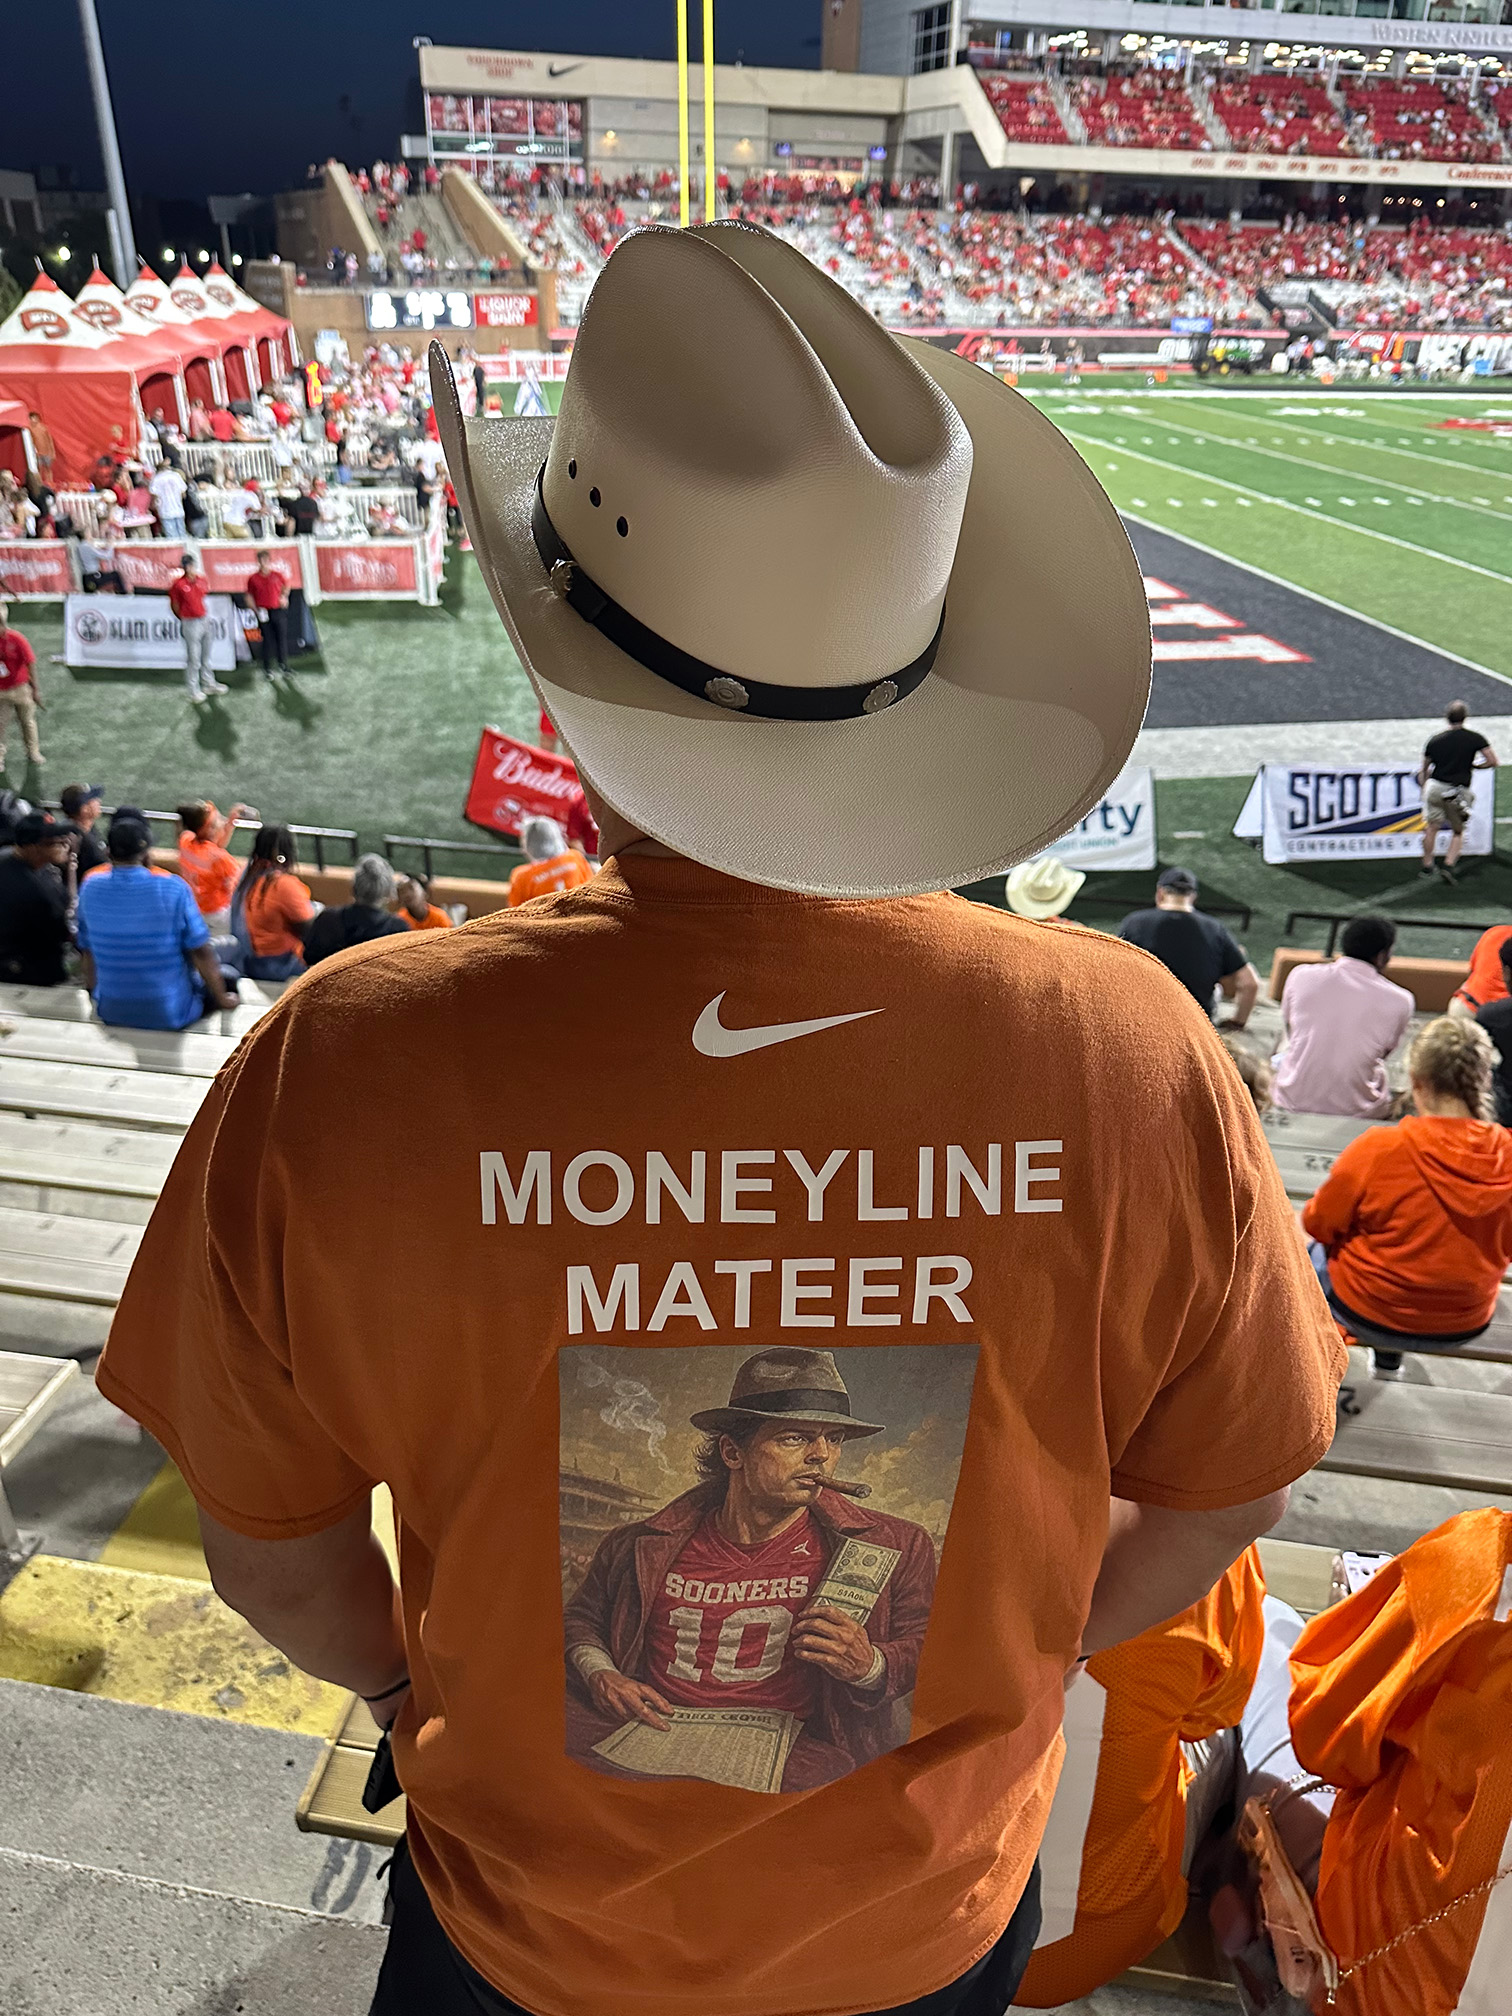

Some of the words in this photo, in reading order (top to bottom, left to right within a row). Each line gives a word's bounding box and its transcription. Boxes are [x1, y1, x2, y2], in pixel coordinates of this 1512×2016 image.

[479, 1139, 1064, 1227] MONEYLINE
[566, 1254, 975, 1335] MATEER
[664, 1572, 810, 1605] SOONERS
[665, 1604, 795, 1684] 10
